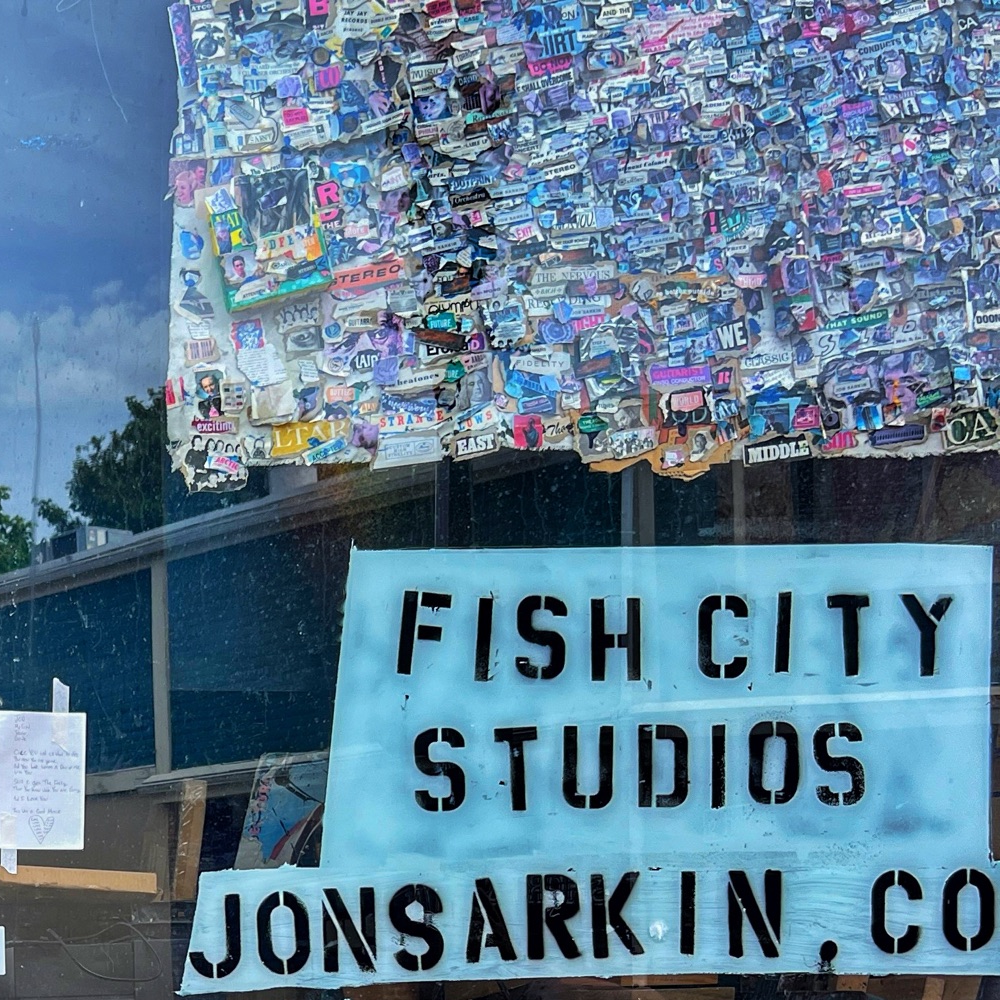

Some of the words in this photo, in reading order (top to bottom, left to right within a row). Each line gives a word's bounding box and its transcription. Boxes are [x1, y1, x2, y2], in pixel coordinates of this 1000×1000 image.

[602, 9, 617, 17] AND
[619, 7, 631, 15] THE
[544, 164, 576, 177] STEREO
[515, 225, 533, 237] EXIT
[328, 264, 401, 287] STEREO
[536, 272, 556, 283] THE
[825, 320, 847, 330] THAT
[850, 311, 884, 325] SOUND
[717, 321, 747, 350] WE
[653, 367, 704, 378] GUITARIST
[670, 375, 706, 384] CONDUCTOR
[946, 413, 996, 445] CA
[456, 434, 494, 456] EAST
[747, 440, 810, 464] MIDDLE
[396, 589, 643, 683] FISH
[695, 591, 957, 680] CITY
[413, 720, 867, 813] STUDIOS
